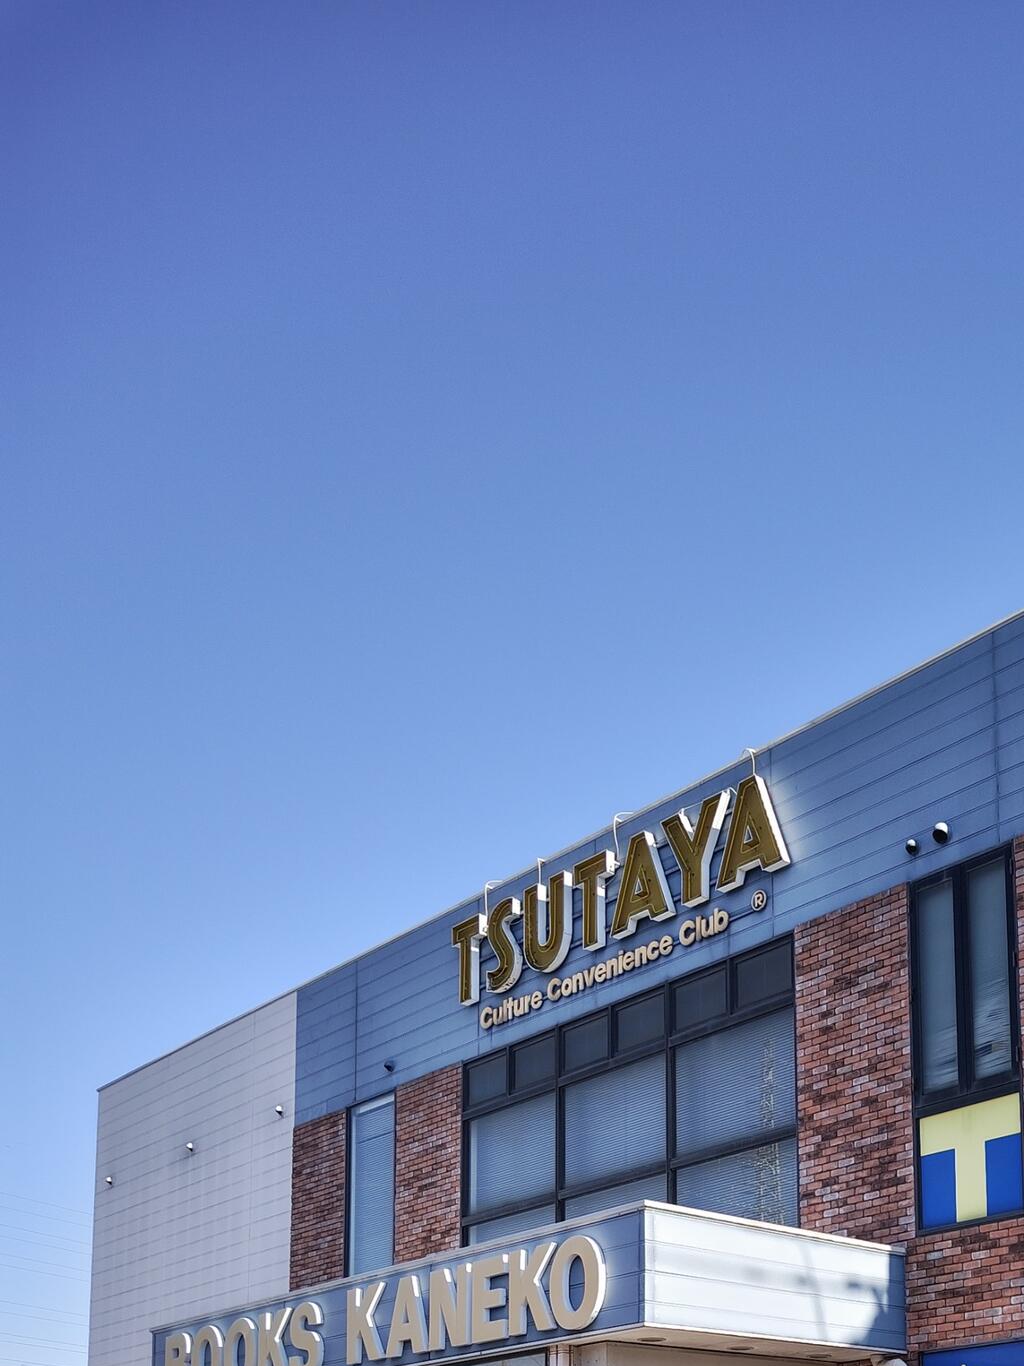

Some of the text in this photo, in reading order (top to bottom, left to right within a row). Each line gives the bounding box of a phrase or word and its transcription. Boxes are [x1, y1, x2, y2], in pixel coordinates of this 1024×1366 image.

[452, 774, 791, 1006] TSUTAYA
[479, 908, 730, 1030] Culture Convenience Club
[346, 1235, 607, 1366] KANEKO
